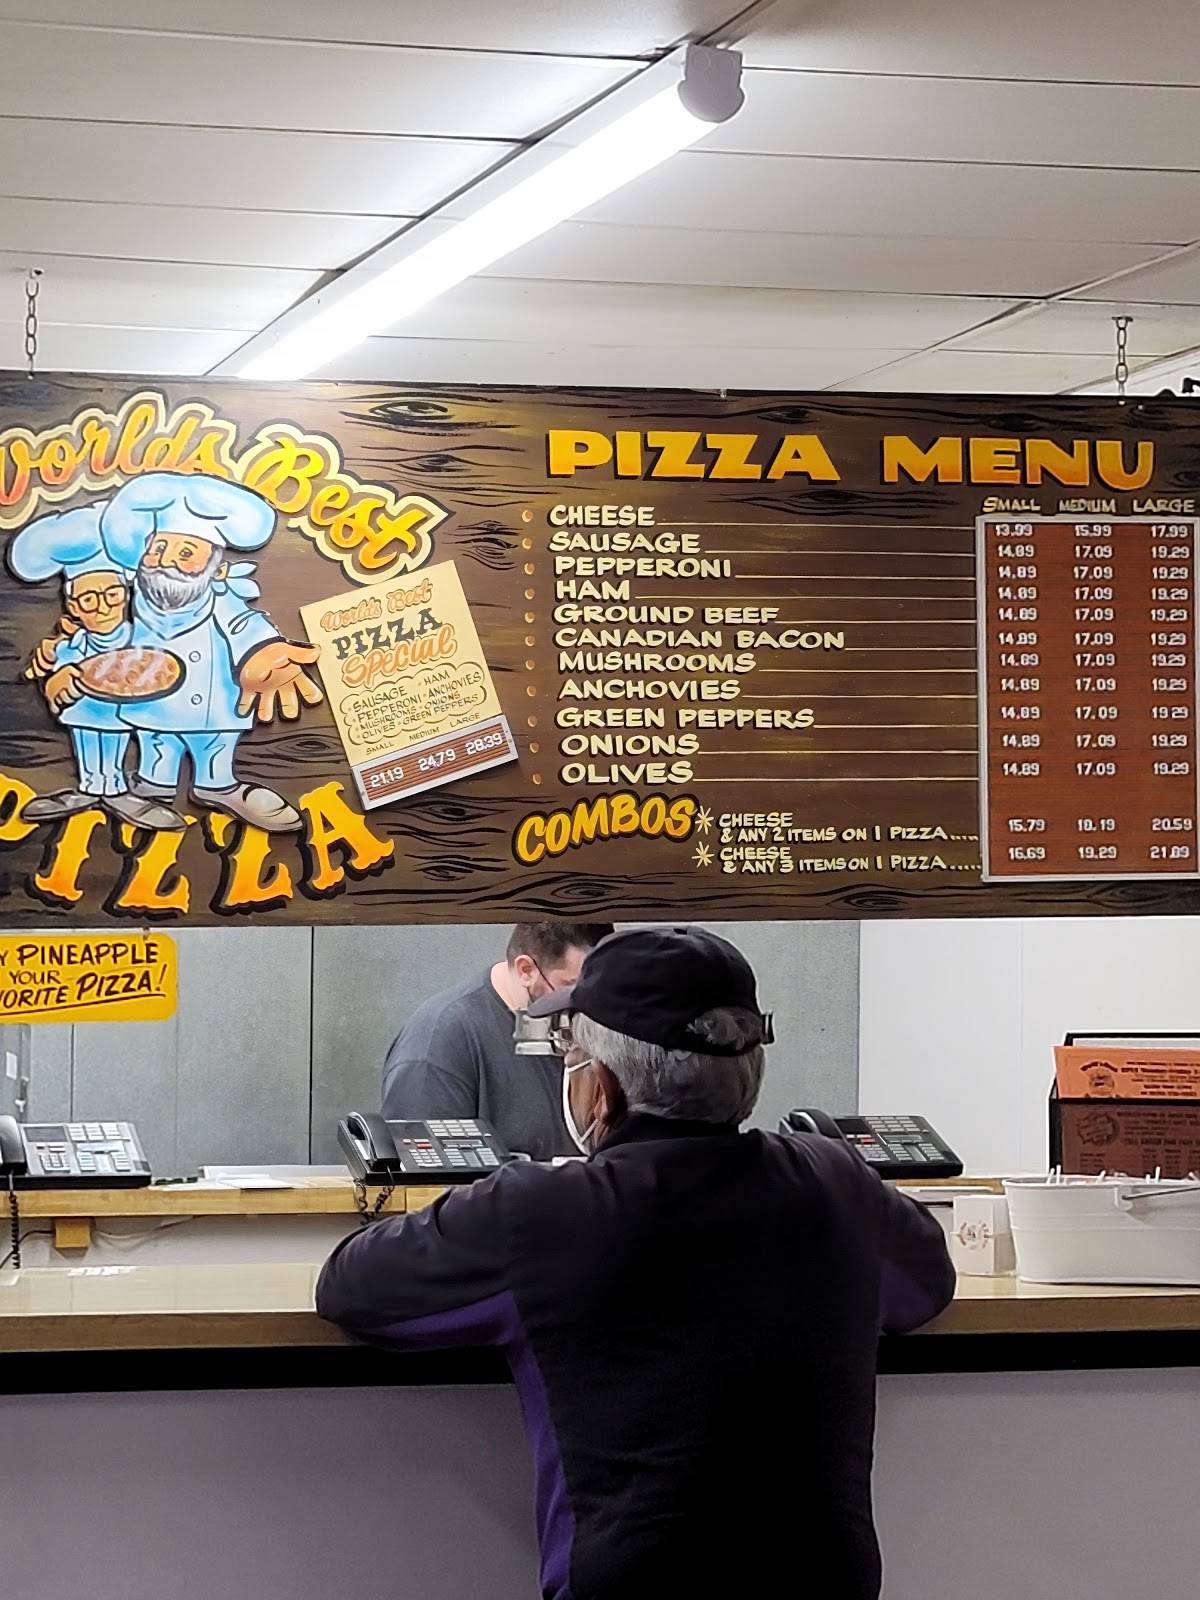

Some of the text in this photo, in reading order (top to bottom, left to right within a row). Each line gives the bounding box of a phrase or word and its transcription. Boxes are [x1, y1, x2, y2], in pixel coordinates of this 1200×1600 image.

[548, 429, 1154, 490] PIZZA MENU
[244, 437, 428, 569] Best
[983, 497, 1195, 513] SMALL MEDIUM LARGE
[550, 505, 655, 526] CHEESE
[1075, 525, 1112, 537] 15.99
[1152, 525, 1188, 537] 17.99
[550, 531, 700, 553] SAUSAGE
[1075, 546, 1113, 558] 17.09
[555, 556, 731, 577] PEPPERONI
[999, 566, 1037, 578] 14.89
[1074, 567, 1113, 579] 17.09
[386, 578, 433, 613] Best
[556, 580, 630, 601] HAM
[1075, 587, 1113, 600] 17.09
[554, 604, 780, 624] GROUND BEEF
[1075, 608, 1114, 620] 17.09
[332, 608, 442, 660] PIZZA
[556, 628, 845, 649] CANADIAN BACON
[1075, 633, 1114, 645] 17.09
[559, 651, 757, 672] MUSHROOMS
[1075, 654, 1115, 666] 17.09
[424, 670, 450, 686] HAM
[1001, 679, 1040, 691] 14.89
[1075, 678, 1116, 691] 17.09
[353, 686, 408, 713] SAUSAGE
[357, 672, 482, 723] PEPPERONI ANCHOVIES
[559, 679, 741, 700] ANCHOVIES
[360, 691, 461, 730] MUSHROOMS ONIONS
[362, 694, 479, 739] OLIVES GREEN PEPPERS
[556, 707, 815, 729] GREEN PEPPERS
[1076, 706, 1118, 719] 17.09
[366, 713, 481, 755] SMALL MEDIUM LARGE
[1076, 735, 1116, 747] 17.09
[418, 749, 457, 772] 24.79
[465, 732, 503, 755] 28.39
[561, 734, 699, 756] ONIONS
[561, 761, 694, 783] OLIVES
[1003, 763, 1040, 775] 14.89
[1077, 763, 1116, 775] 17.09
[517, 793, 697, 862] COMBOS
[719, 813, 793, 827] CHEESE
[1008, 819, 1045, 832] 15.79
[1152, 818, 1193, 831] 20.59
[720, 828, 734, 843] &
[738, 828, 768, 842] ANY
[772, 827, 785, 842] 2
[788, 827, 837, 841] ITEMS
[842, 827, 867, 840] ON
[720, 846, 793, 860] CHEESE
[1008, 847, 1046, 859] 16.69
[1078, 846, 1117, 859] 19.29
[723, 861, 737, 874] &
[741, 860, 776, 873] ANY
[780, 860, 794, 873] 3
[799, 858, 847, 871] ITEMS
[848, 857, 869, 870] ON
[16, 943, 159, 967] PINEAPPLE
[9, 970, 62, 985] YOUR
[76, 963, 168, 1001] PIZZA!
